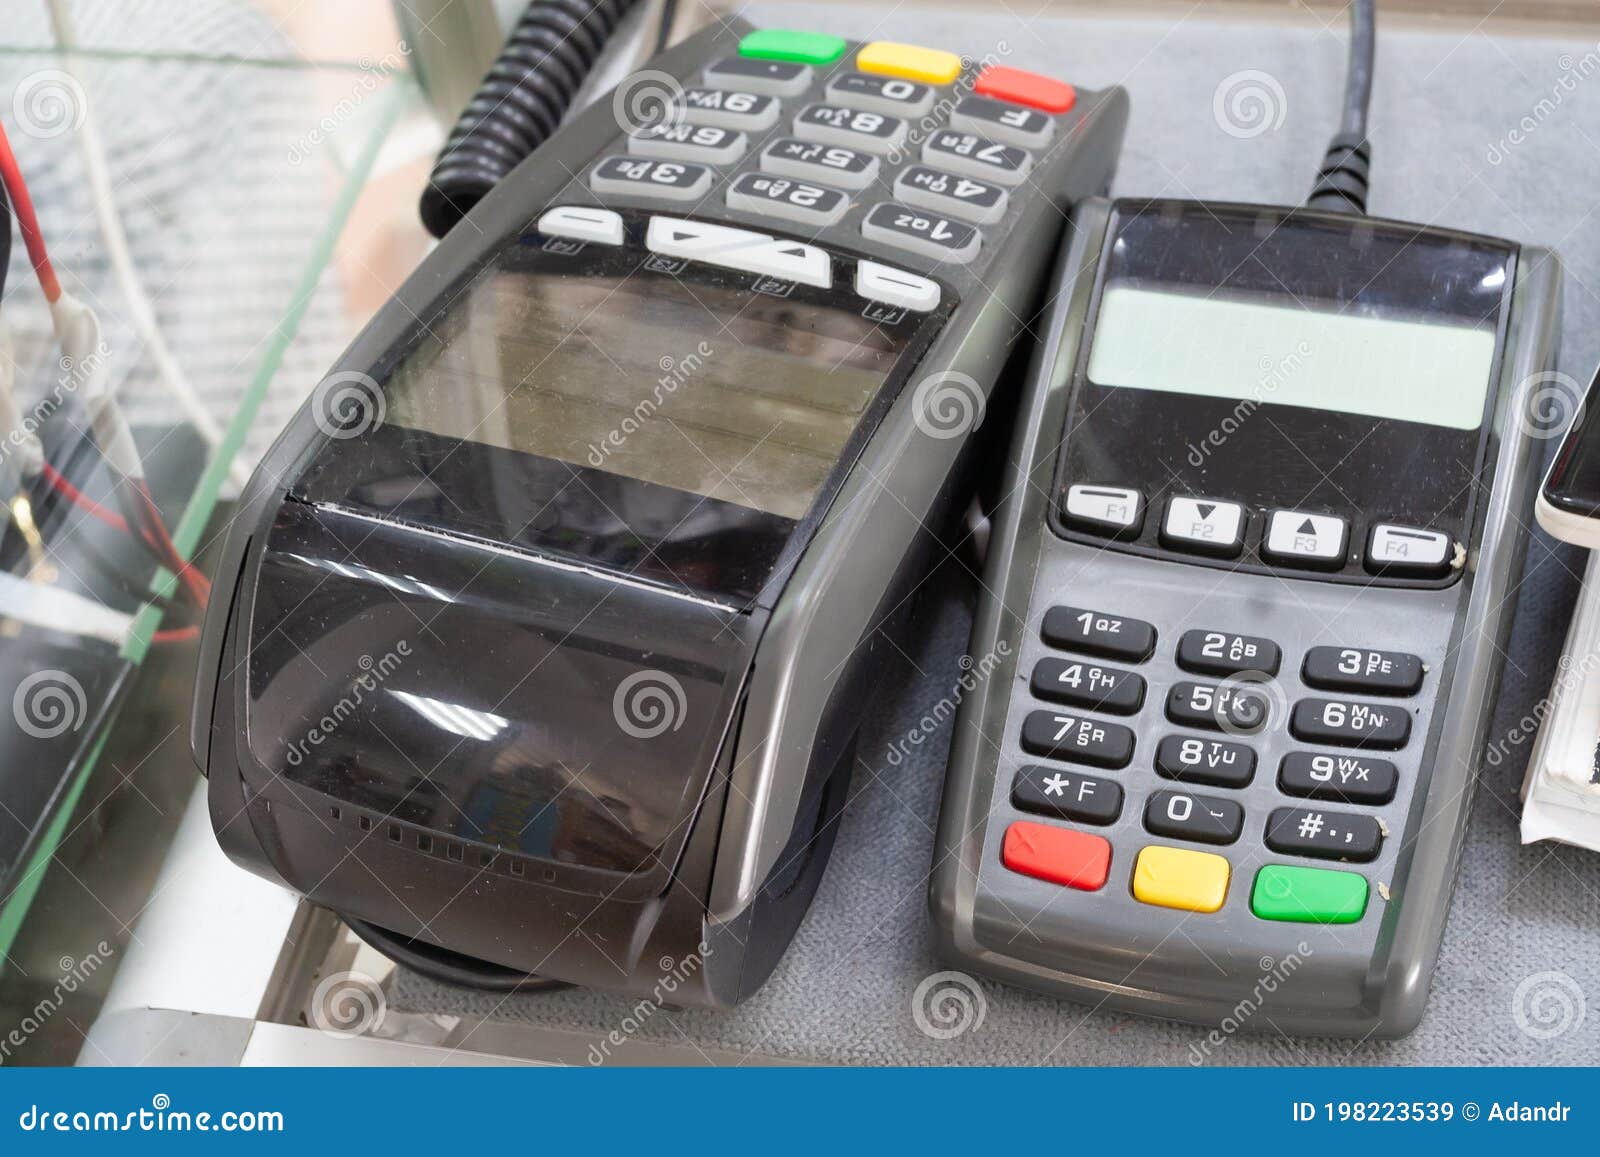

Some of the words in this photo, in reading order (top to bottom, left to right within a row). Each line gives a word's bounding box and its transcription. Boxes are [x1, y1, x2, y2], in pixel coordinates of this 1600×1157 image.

[724, 93, 757, 112] 9
[851, 113, 885, 132] 8
[1000, 110, 1031, 127] F
[821, 148, 855, 168] 5
[976, 144, 1006, 163] 7
[651, 163, 686, 183] 3
[789, 184, 825, 206] 2
[953, 179, 987, 198] 4
[930, 219, 953, 240] 1
[1105, 503, 1128, 521] F1
[1190, 522, 1214, 538] F2
[1293, 537, 1317, 554] F3
[1384, 542, 1409, 558] F4
[1201, 633, 1226, 658] 2
[1338, 650, 1361, 674] 3
[1058, 665, 1082, 688] 4
[1190, 687, 1213, 711] 5
[1322, 703, 1346, 728] 6
[1053, 717, 1076, 742] 7
[1179, 740, 1203, 765] 8
[1310, 757, 1334, 782] 9
[1078, 782, 1097, 801] F
[1167, 796, 1193, 821] 0
